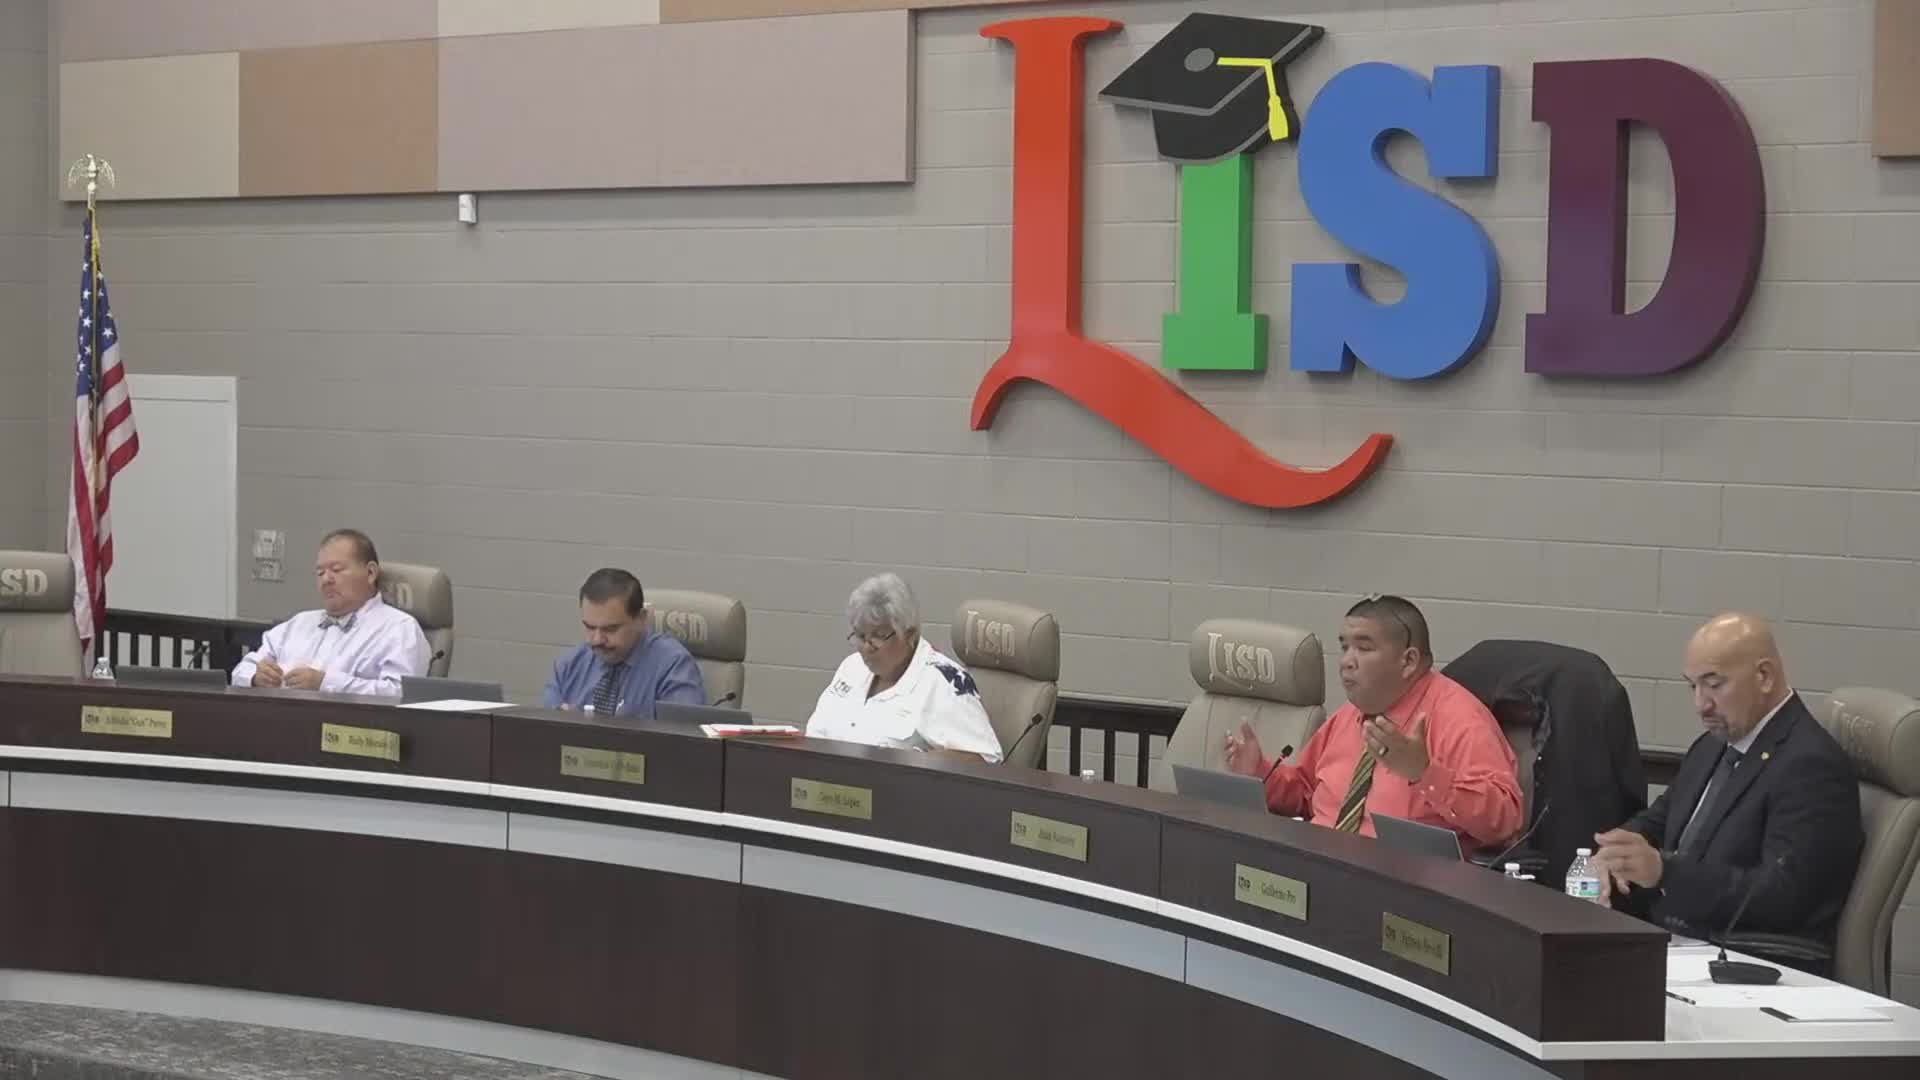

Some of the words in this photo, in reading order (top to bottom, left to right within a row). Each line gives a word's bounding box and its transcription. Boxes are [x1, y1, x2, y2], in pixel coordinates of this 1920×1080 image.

[971, 16, 1767, 509] LISD
[964, 609, 1017, 660] LISD
[1207, 631, 1276, 690] LISD
